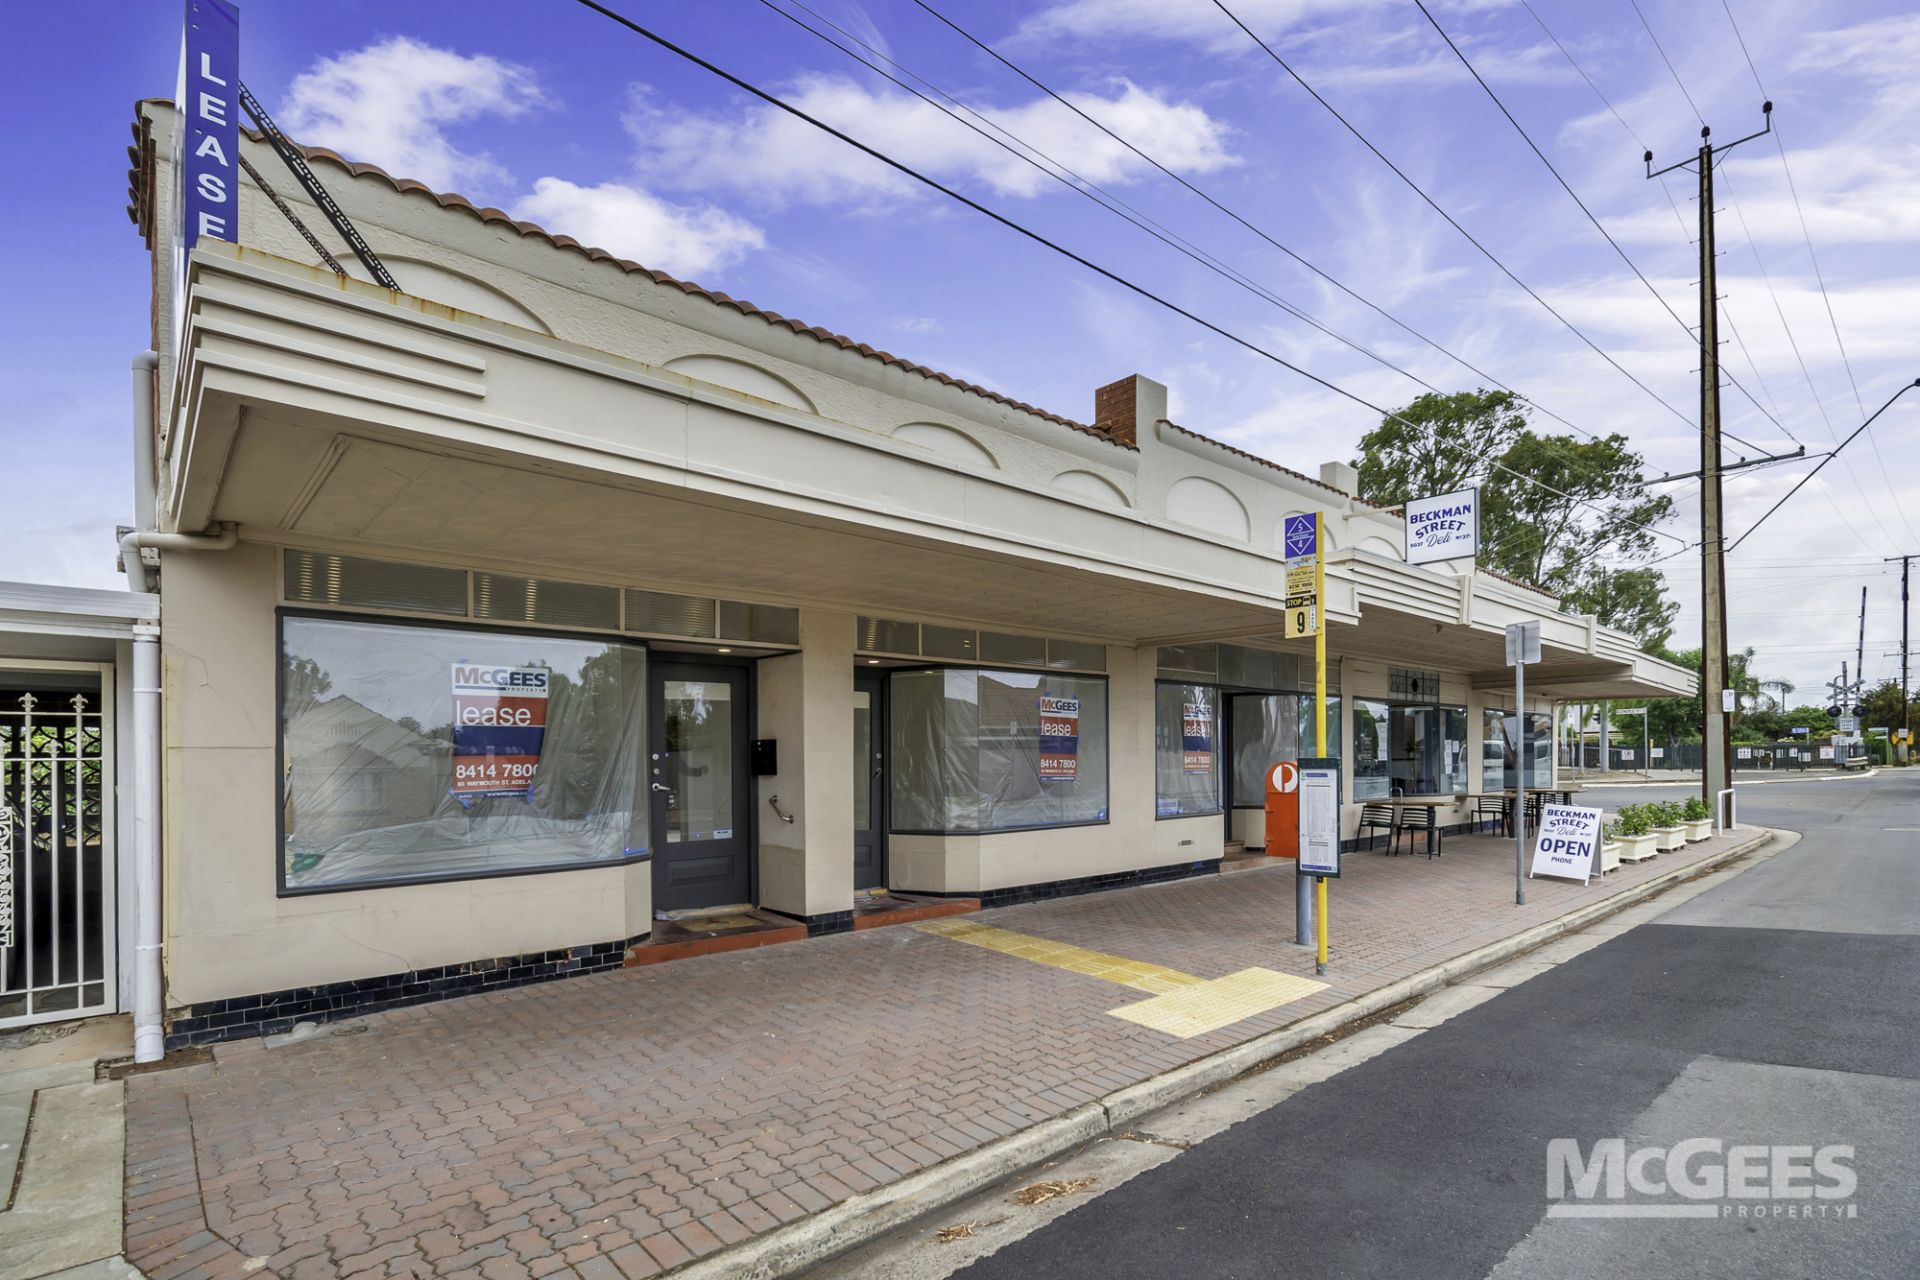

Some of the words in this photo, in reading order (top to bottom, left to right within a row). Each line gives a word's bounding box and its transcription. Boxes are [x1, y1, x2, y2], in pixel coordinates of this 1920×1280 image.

[196, 52, 229, 241] LEASE
[1410, 504, 1471, 524] BECKMAN
[1298, 523, 1303, 532] 5
[1415, 520, 1466, 539] STREET
[1297, 539, 1303, 548] 4
[1426, 531, 1452, 547] Deli
[1287, 599, 1302, 607] STOP
[1297, 611, 1305, 634] 9
[454, 667, 546, 687] McGEES
[1041, 698, 1078, 711] McGEES
[456, 700, 531, 726] lease
[1041, 720, 1072, 736] lease
[1040, 759, 1058, 768] 8414
[1060, 759, 1076, 768] 7800
[456, 765, 497, 778] 8414
[1547, 809, 1596, 820] BECKMAN
[1550, 818, 1590, 830] STREET
[1556, 826, 1578, 836] Deli
[1540, 837, 1591, 857] OPEN
[1551, 856, 1573, 864] PHONE
